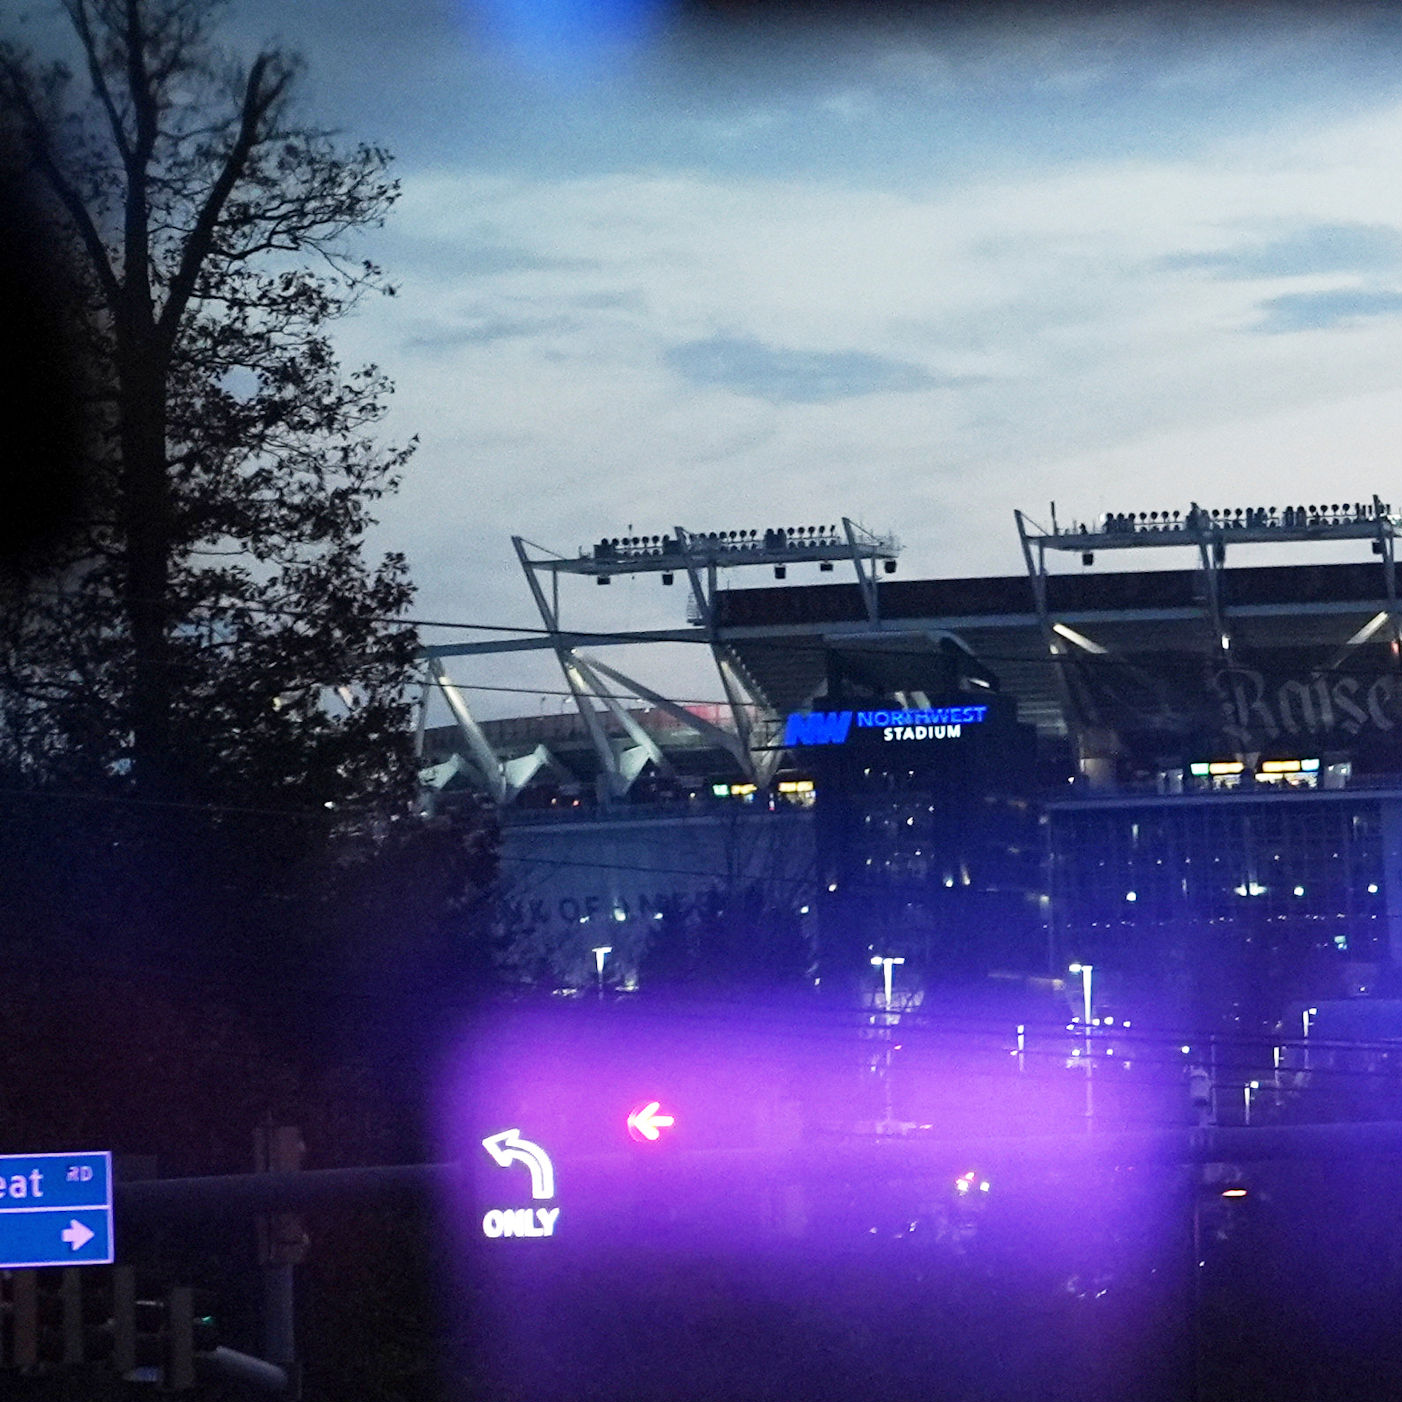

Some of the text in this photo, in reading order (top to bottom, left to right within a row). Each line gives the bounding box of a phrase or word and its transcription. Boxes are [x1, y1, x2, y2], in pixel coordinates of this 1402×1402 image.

[856, 706, 988, 727] NORTHWEST
[884, 724, 961, 742] STADIUM
[66, 1165, 94, 1182] RD
[482, 1207, 560, 1238] ONLY
